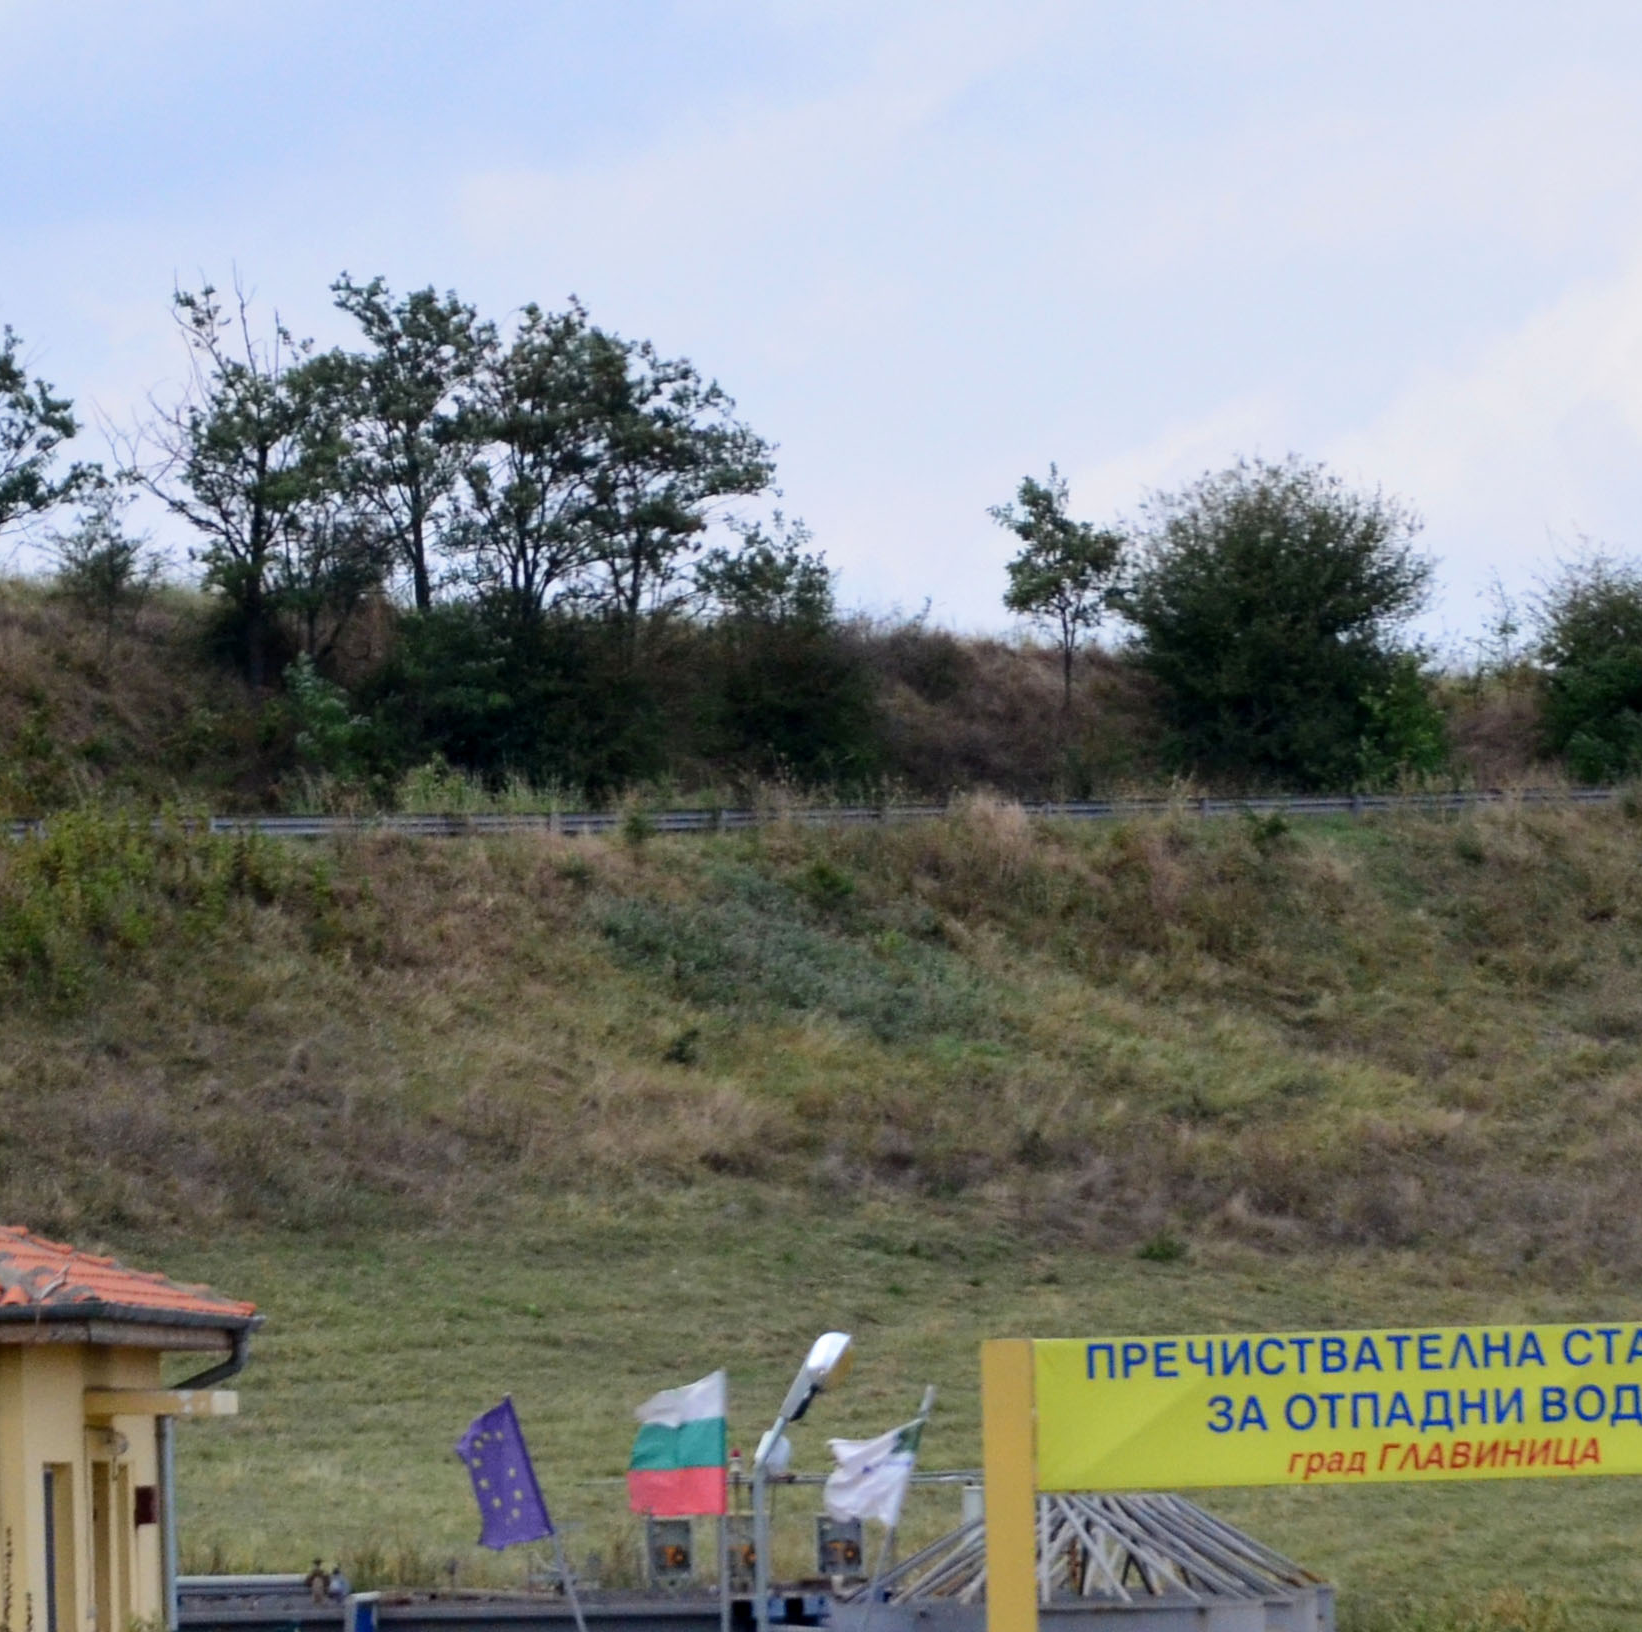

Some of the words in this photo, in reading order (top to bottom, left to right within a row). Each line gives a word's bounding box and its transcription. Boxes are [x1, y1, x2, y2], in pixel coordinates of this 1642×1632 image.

[1086, 1331, 1547, 1379] ПРЕЧИСТВАТЕЛНА
[1207, 1394, 1269, 1434] ЗА
[1284, 1387, 1525, 1432] ОТПАДНИ
[1287, 1450, 1367, 1481] град
[1377, 1437, 1602, 1472] ГЛАВИНИЦА
